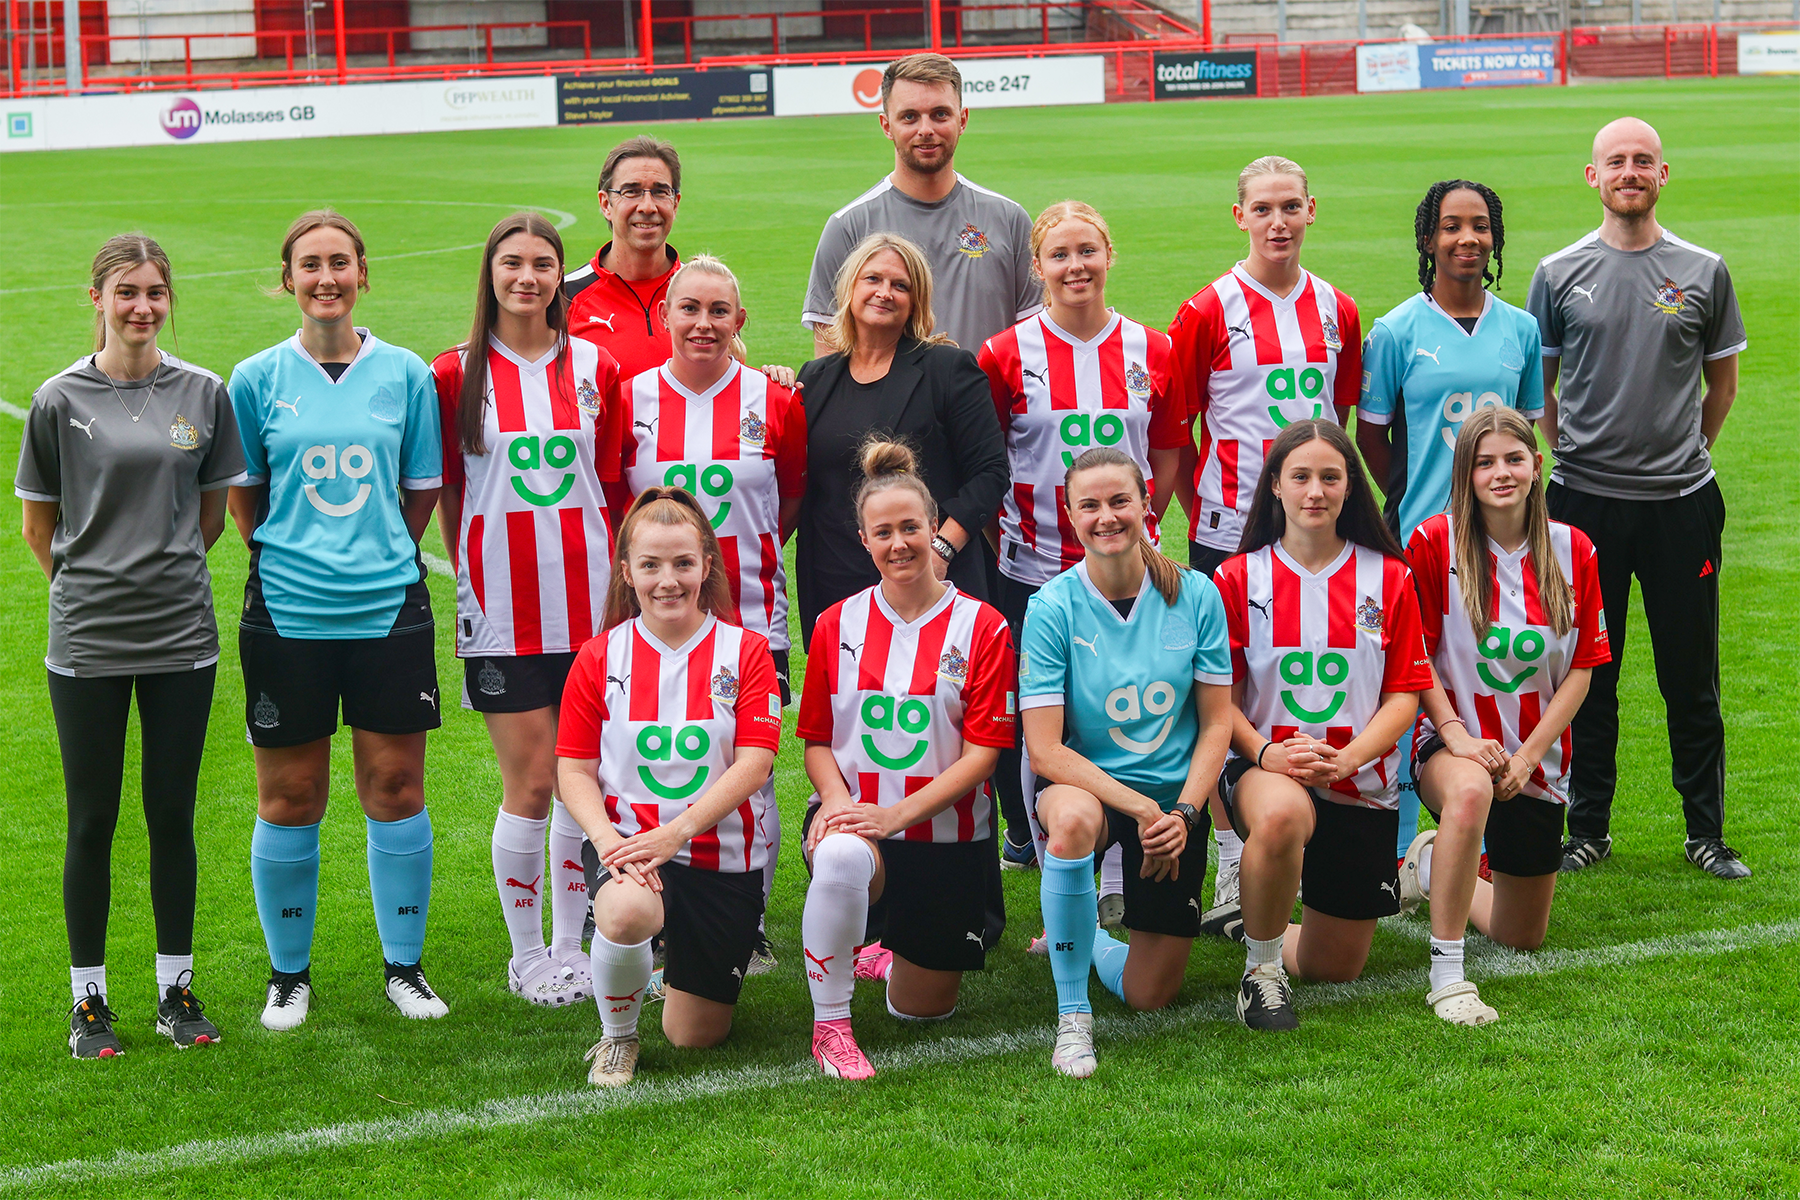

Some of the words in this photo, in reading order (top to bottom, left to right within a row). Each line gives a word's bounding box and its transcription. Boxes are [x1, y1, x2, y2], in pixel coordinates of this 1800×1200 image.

[1157, 60, 1253, 81] totalfitness
[1431, 55, 1482, 71] TICKETS
[1483, 54, 1518, 69] NOW
[1519, 53, 1540, 68] ON
[1542, 52, 1554, 68] S
[563, 81, 596, 90] Achieve
[597, 80, 615, 90] your
[615, 78, 650, 88] financial
[651, 77, 680, 87] GOALS
[999, 75, 1030, 92] 247
[564, 96, 581, 106] with
[583, 96, 600, 106] your
[601, 94, 622, 104] local
[622, 93, 659, 103] Financial
[204, 109, 285, 124] Molasses
[289, 106, 316, 121] GB
[564, 111, 588, 120] Steve
[588, 110, 614, 120] Taylor
[1266, 367, 1324, 401] ao
[1060, 413, 1124, 446] ao
[508, 435, 576, 470] ao
[301, 444, 374, 480] ao
[663, 463, 734, 498] ao
[1477, 626, 1546, 662] ao
[1279, 651, 1349, 686] ao
[1105, 680, 1176, 722] ao
[861, 694, 931, 735] ao
[636, 725, 711, 761] ao
[1037, 832, 1050, 842] AF
[567, 881, 587, 893] AFC
[397, 905, 419, 916] AFC
[514, 898, 534, 908] AFC
[281, 907, 303, 919] AFC
[1055, 941, 1075, 952] AFC
[808, 969, 824, 983] AFC
[610, 1004, 631, 1014] AFC
